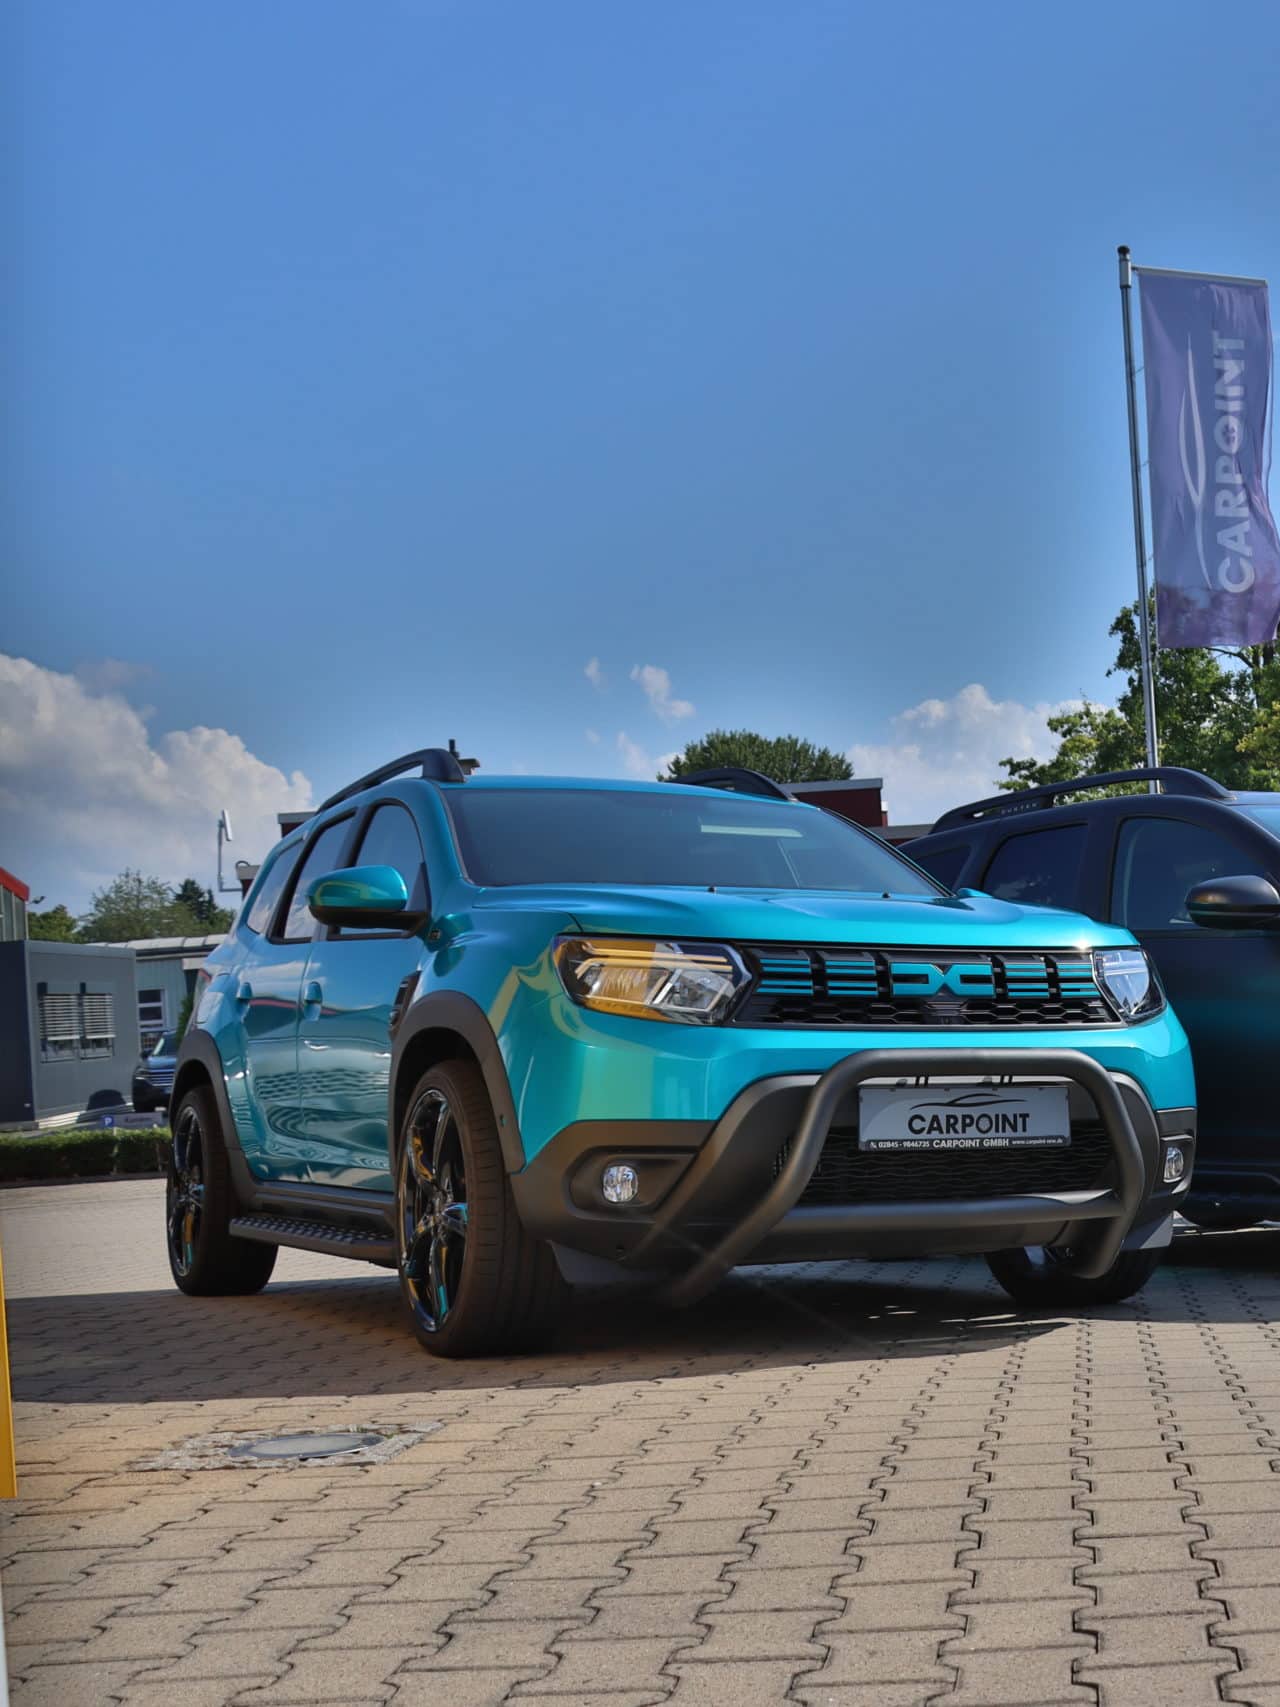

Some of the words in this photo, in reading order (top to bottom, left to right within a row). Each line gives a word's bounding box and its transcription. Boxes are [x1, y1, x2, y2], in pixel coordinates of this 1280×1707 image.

[1212, 330, 1256, 595] CARPOINT
[908, 1113, 1030, 1135] CARPOINT
[932, 1139, 981, 1149] CARPOINT
[982, 1138, 1009, 1147] GMBH
